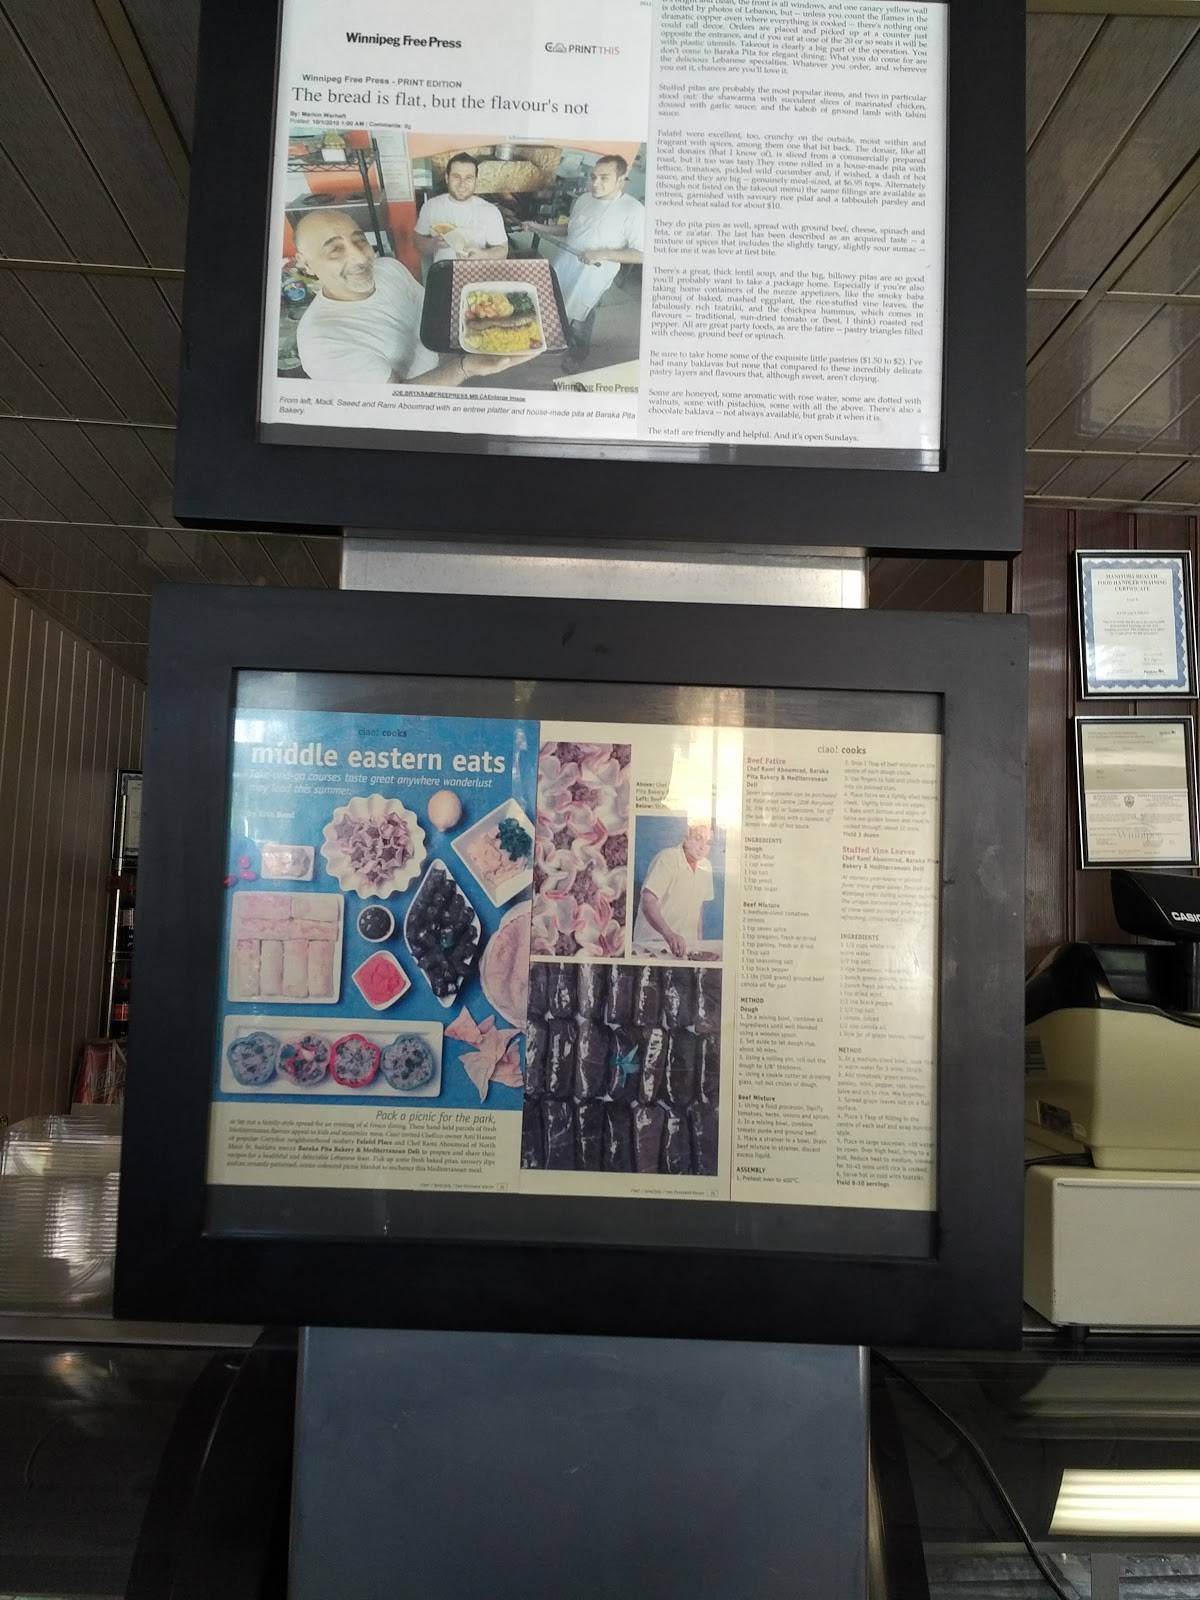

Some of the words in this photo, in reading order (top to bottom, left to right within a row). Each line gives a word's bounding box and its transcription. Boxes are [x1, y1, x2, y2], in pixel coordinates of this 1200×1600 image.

[346, 32, 400, 48] Winnipeg
[403, 35, 428, 47] Free
[429, 36, 462, 49] Press
[568, 44, 596, 54] PRINT
[600, 46, 620, 55] THIS
[302, 73, 342, 85] Winnipeg
[344, 75, 363, 84] Free
[365, 76, 389, 85] Press
[397, 77, 422, 86] PRINT
[426, 78, 462, 88] EDITION
[292, 88, 322, 102] The
[328, 89, 370, 104] bread
[377, 92, 389, 105] is
[395, 92, 426, 108] flat,
[431, 93, 454, 108] but
[461, 94, 484, 109] the
[491, 96, 558, 112] flavour's
[564, 100, 587, 114] not
[649, 368, 672, 378] pastry
[674, 368, 697, 379] layers
[766, 371, 799, 382] although
[552, 382, 593, 393] Winneg
[596, 383, 613, 392] Free
[615, 384, 638, 393] Press
[649, 388, 669, 396] Some
[877, 395, 902, 403] dotted
[279, 396, 298, 404] From
[336, 399, 360, 407] Saeed
[376, 400, 396, 409] Rami
[436, 403, 450, 411] with
[511, 406, 524, 414] and
[571, 410, 584, 419] pita
[595, 410, 620, 419] Baraka
[621, 411, 635, 419] Pita
[648, 406, 682, 414] chocolate
[684, 407, 714, 415] baklava
[737, 408, 764, 419] always
[817, 411, 834, 421] grab
[843, 411, 864, 419] when
[695, 428, 724, 438] friendly
[382, 729, 407, 738] cooks
[817, 745, 838, 754] ciao!
[841, 745, 867, 755] cooks
[252, 742, 338, 767] middle
[348, 748, 442, 770] eastern
[453, 750, 505, 773] eats
[308, 773, 341, 782] courses
[345, 774, 368, 784] taste
[371, 775, 395, 785] great
[398, 776, 440, 787] anywhere
[444, 778, 493, 788] wanderlust
[759, 774, 779, 783] Bakery
[376, 1110, 397, 1120] Pack
[409, 1112, 436, 1122] picnic
[438, 1112, 451, 1123] for
[455, 1113, 470, 1123] the
